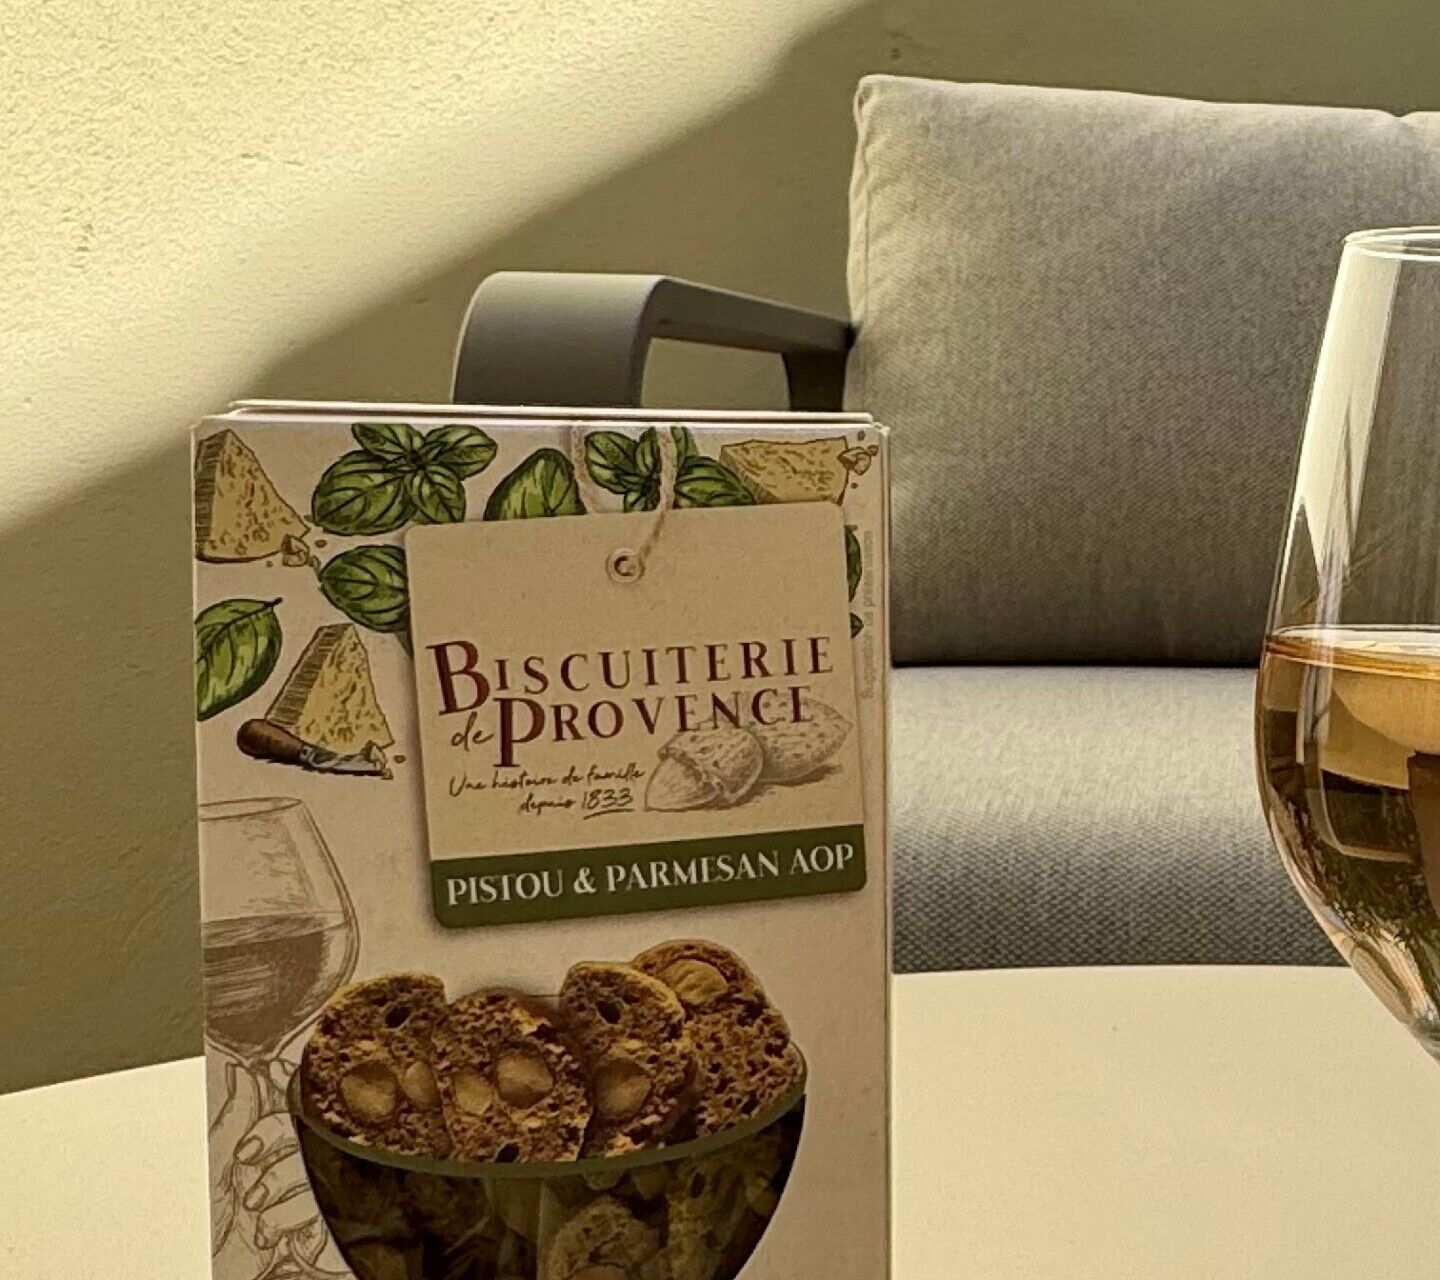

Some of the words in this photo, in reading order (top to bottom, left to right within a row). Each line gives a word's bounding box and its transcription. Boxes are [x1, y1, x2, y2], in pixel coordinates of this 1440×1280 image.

[425, 636, 834, 716] BISCUITERIE
[451, 712, 494, 752] de
[493, 686, 813, 768] PROVENCE
[450, 771, 486, 797] Une
[561, 765, 583, 786] de
[581, 787, 635, 810] 1833
[446, 869, 563, 906] PISTOU
[573, 865, 597, 895] &
[605, 849, 780, 893] PARMESAN
[791, 843, 855, 875] AOP
